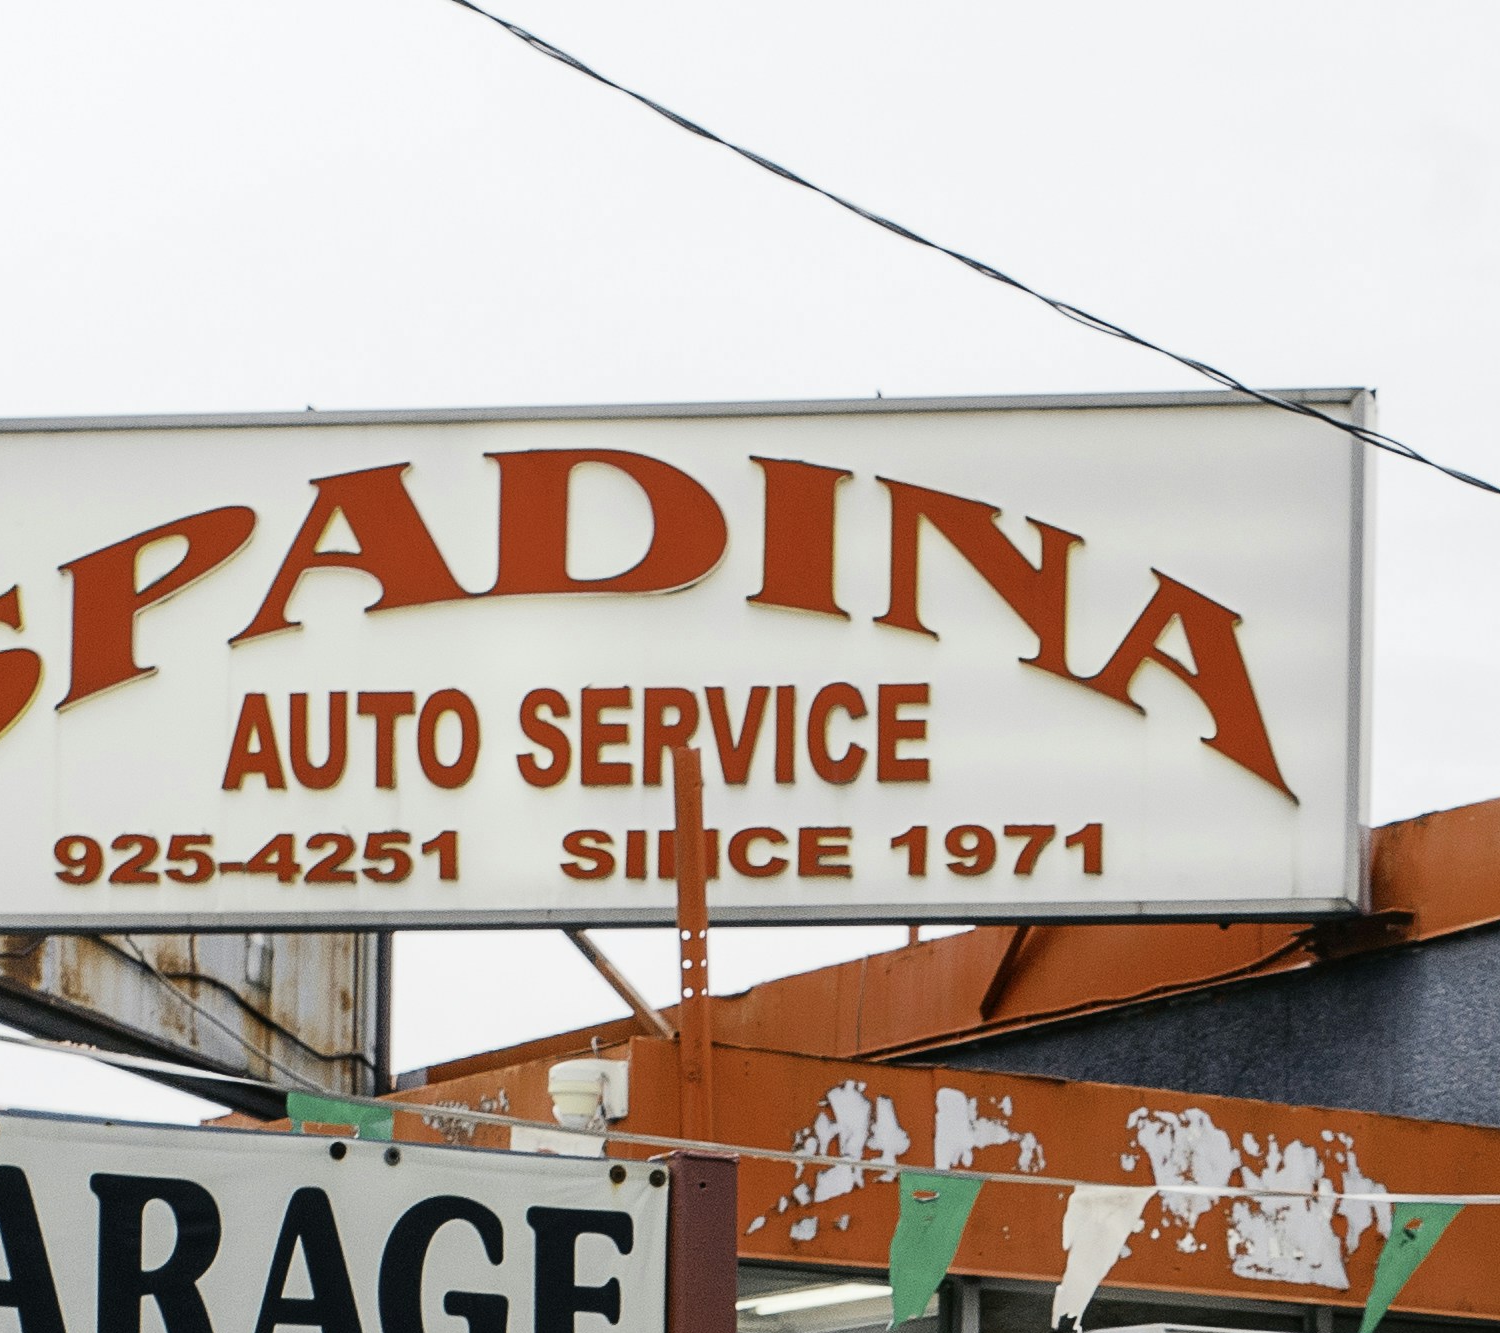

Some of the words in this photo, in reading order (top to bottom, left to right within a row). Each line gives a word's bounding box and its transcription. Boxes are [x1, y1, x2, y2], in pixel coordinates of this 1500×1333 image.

[222, 690, 481, 791] AUTO
[517, 683, 932, 790] SERVICE
[54, 831, 459, 886] 925-4251
[890, 824, 1104, 878] 1971
